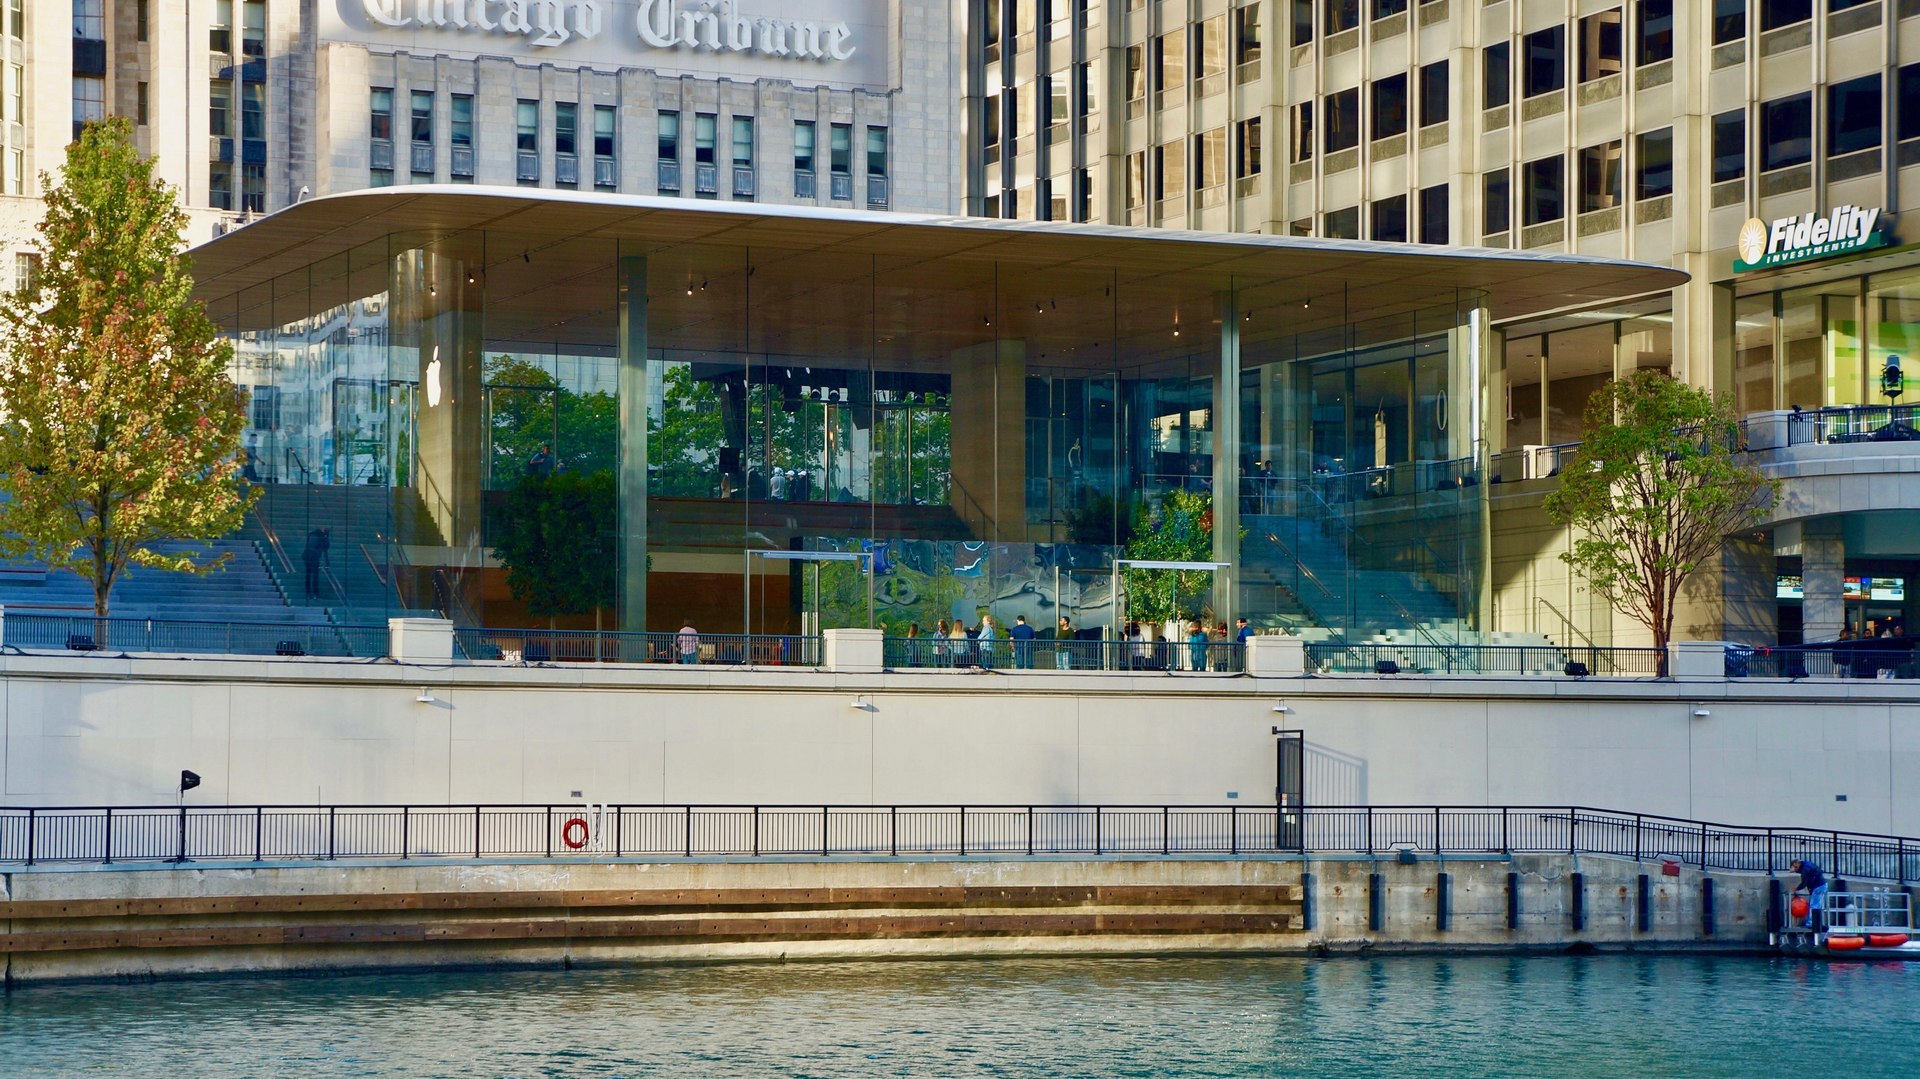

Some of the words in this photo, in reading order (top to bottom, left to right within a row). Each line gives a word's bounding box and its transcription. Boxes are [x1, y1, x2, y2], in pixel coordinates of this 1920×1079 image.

[637, 0, 856, 60] Tribune
[1767, 239, 1855, 263] INVESTMENTS
[1768, 205, 1880, 254] Fidelity
